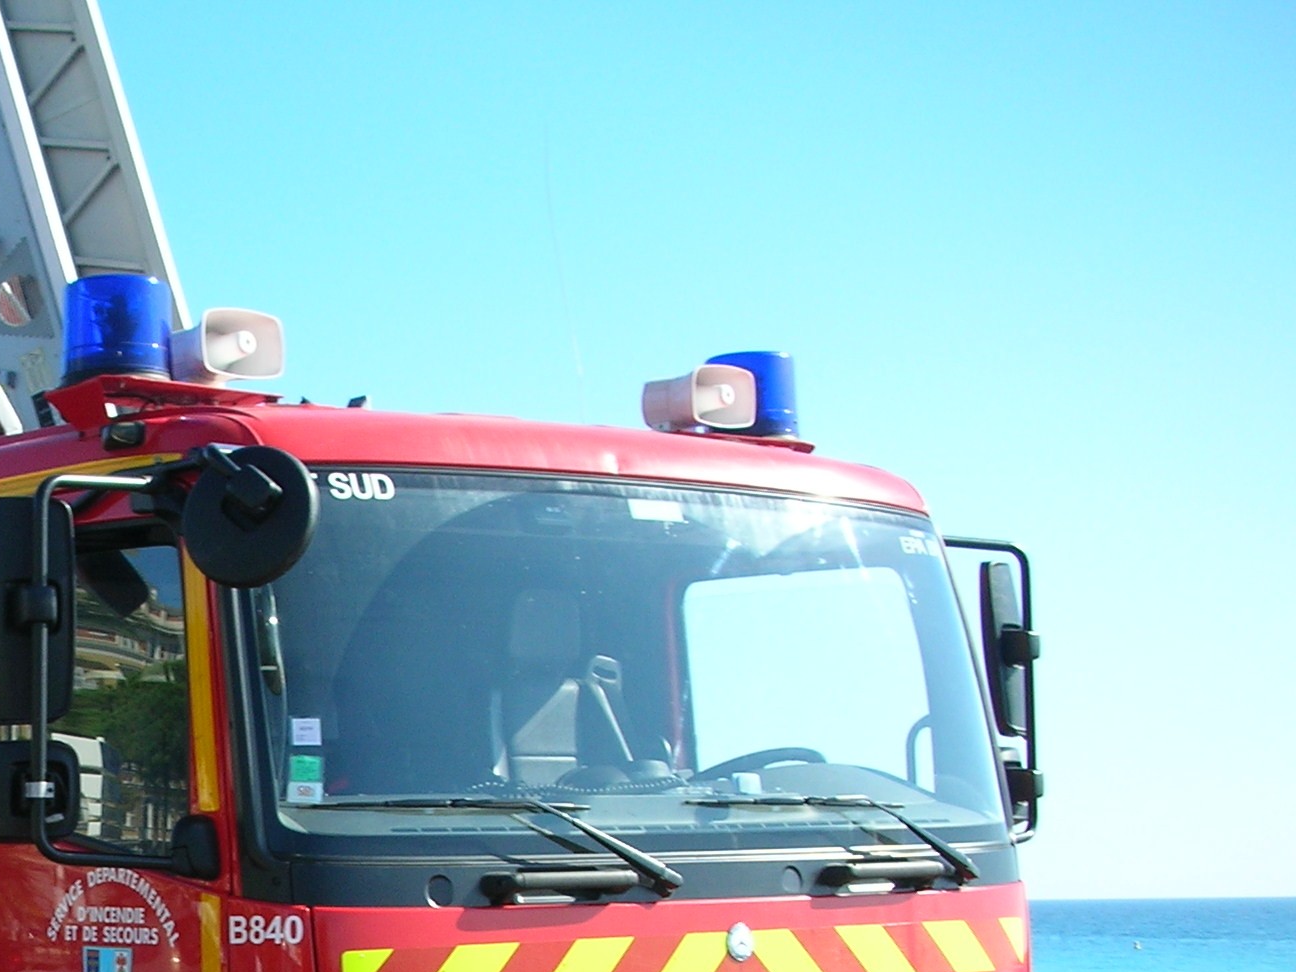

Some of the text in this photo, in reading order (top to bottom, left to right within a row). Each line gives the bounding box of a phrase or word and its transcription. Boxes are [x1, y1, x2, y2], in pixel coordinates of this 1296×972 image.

[327, 472, 396, 501] SUD
[47, 867, 180, 948] SERVICE DEPARTEMENTAL
[76, 906, 146, 924] D'INCENDIE
[65, 925, 160, 945] ET DE SECOURS
[229, 915, 304, 945] B840
